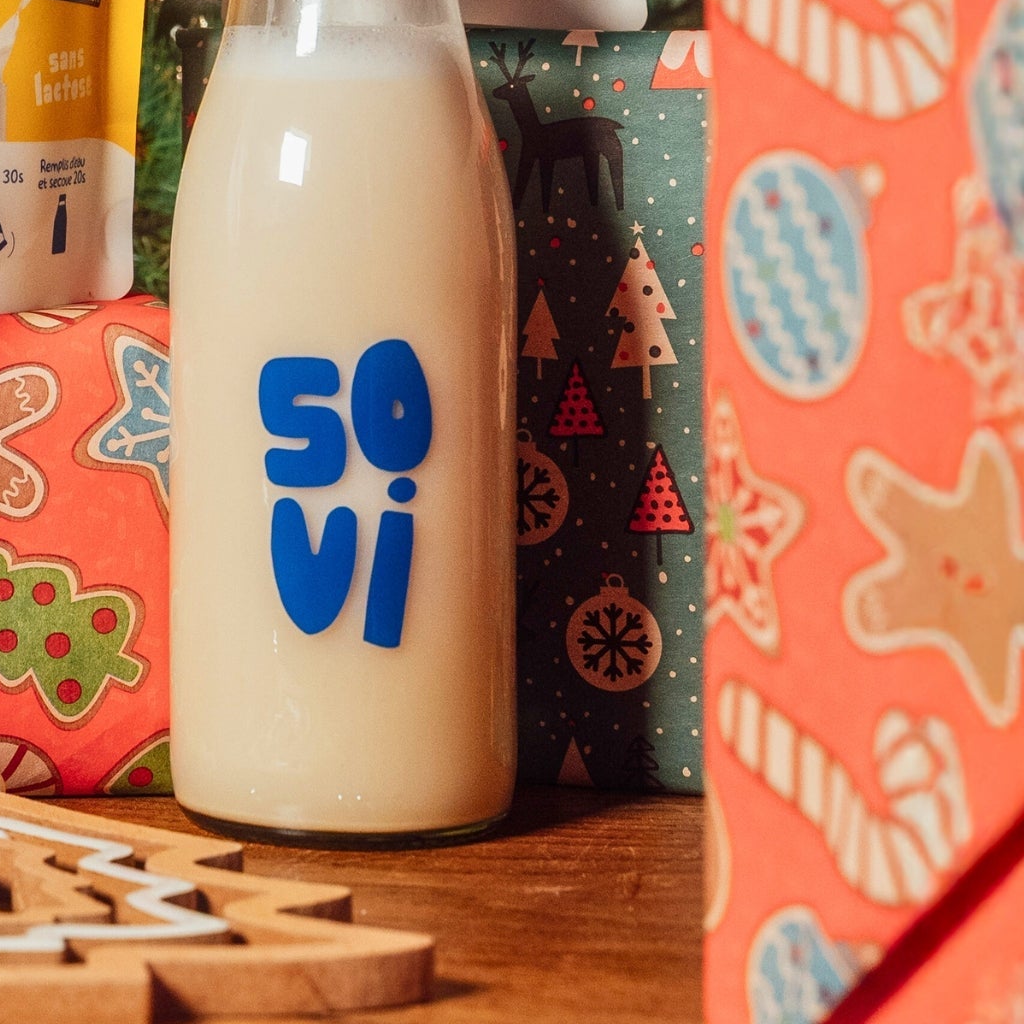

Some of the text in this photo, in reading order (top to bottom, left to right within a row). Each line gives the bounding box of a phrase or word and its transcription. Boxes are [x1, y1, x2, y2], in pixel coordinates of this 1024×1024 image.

[49, 48, 85, 73] sans
[34, 71, 93, 107] lactose
[2, 169, 24, 185] 30s
[40, 159, 69, 174] Remplis
[37, 169, 86, 190] et secoue 20s
